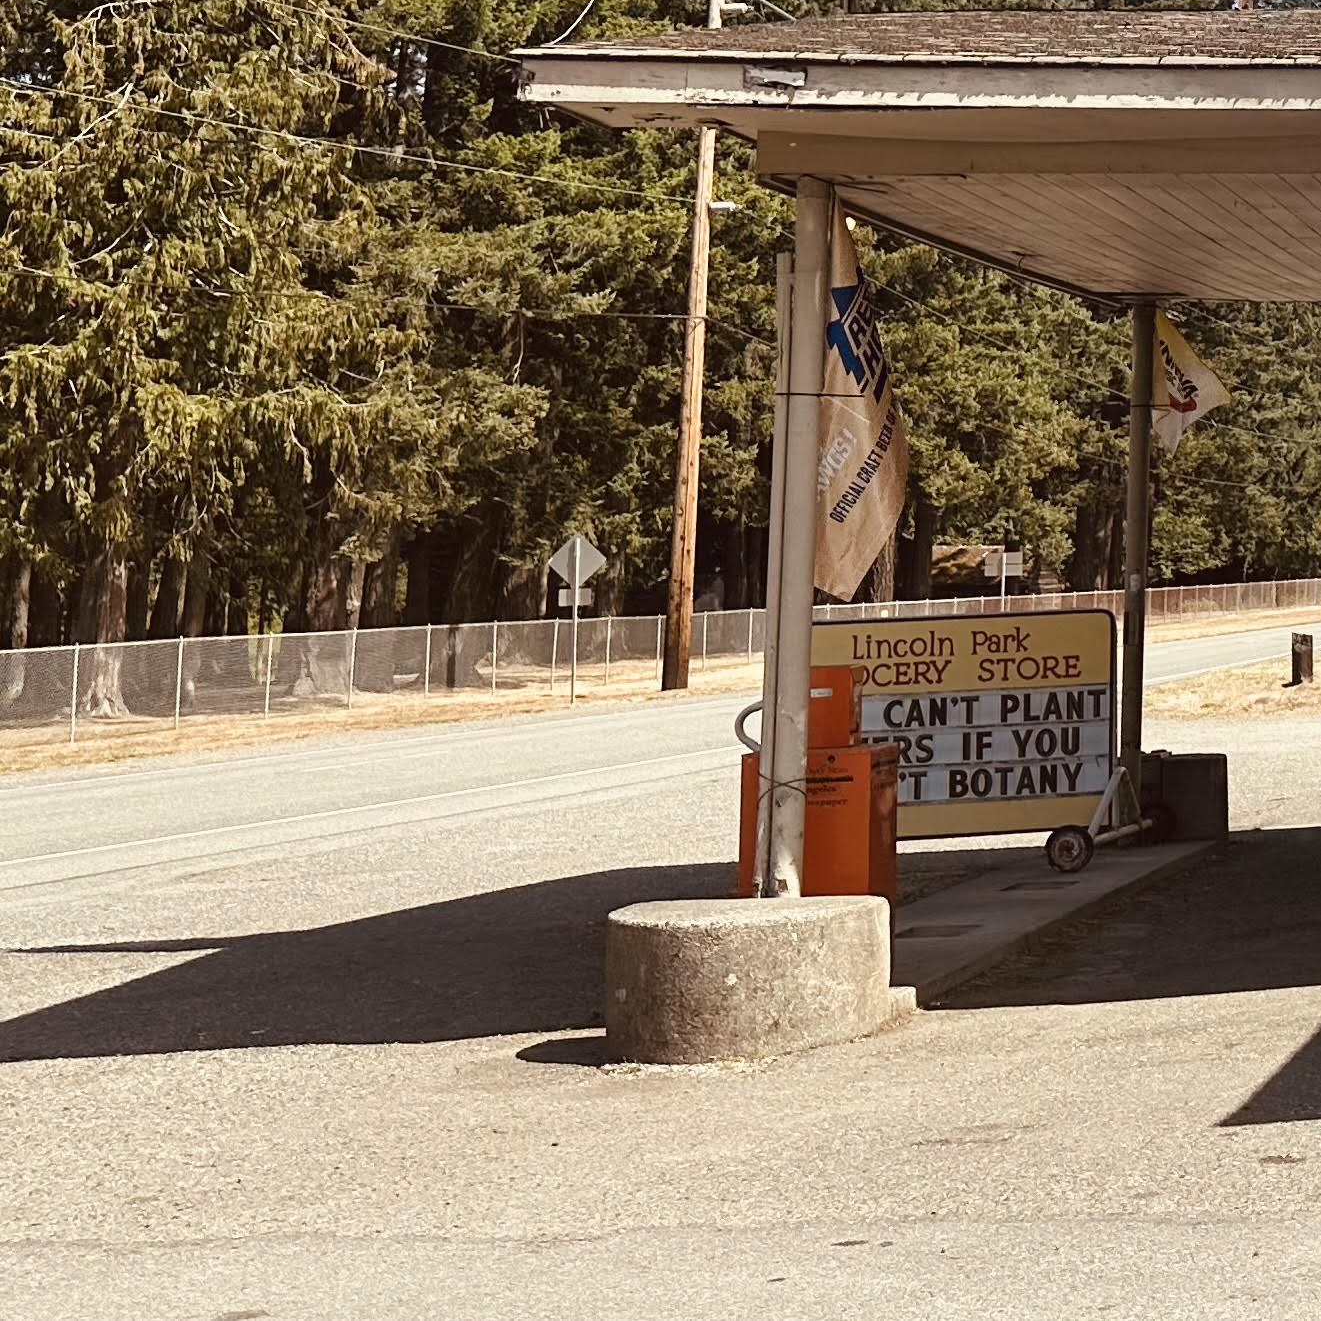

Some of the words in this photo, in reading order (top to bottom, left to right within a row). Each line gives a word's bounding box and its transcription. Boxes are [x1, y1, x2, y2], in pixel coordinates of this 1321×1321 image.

[829, 481, 867, 523] OFFICIAL
[856, 448, 885, 484] CRAFT
[875, 423, 894, 452] BEER
[852, 630, 955, 660] Lincoln
[971, 627, 1031, 655] Park
[861, 659, 952, 687] CERY
[977, 655, 1082, 682] STORE
[883, 695, 980, 728] CAN'T
[1000, 688, 1107, 723] PLANT
[962, 730, 992, 761] IF
[1011, 726, 1080, 758] YOU
[948, 761, 1084, 799] BOTANY
